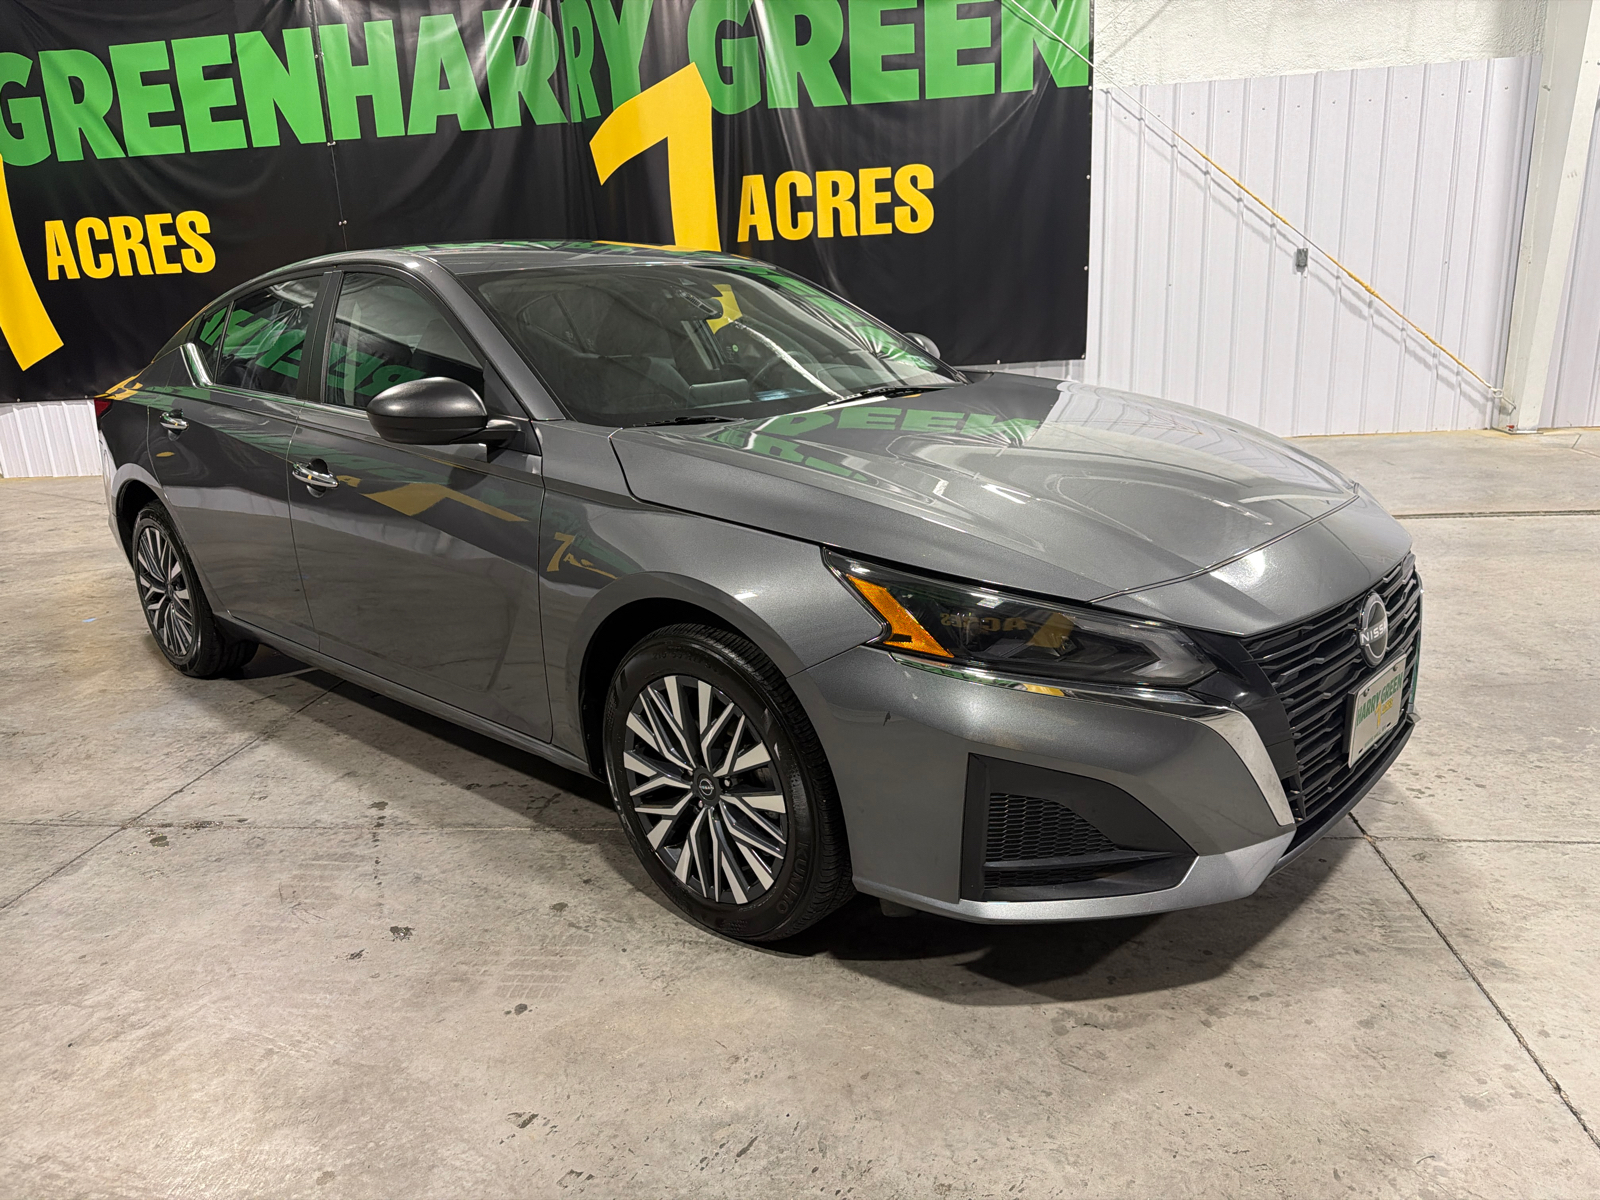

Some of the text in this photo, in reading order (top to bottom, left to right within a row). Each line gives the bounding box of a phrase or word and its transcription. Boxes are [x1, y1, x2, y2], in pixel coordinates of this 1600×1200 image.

[0, 27, 326, 168] GREEN
[316, 0, 1091, 141] HARRY GREEN
[737, 163, 935, 243] ACRES
[44, 210, 217, 282] ACRES
[1361, 621, 1387, 644] NISS
[1356, 689, 1381, 727] HARRY
[1381, 671, 1404, 704] GREEN
